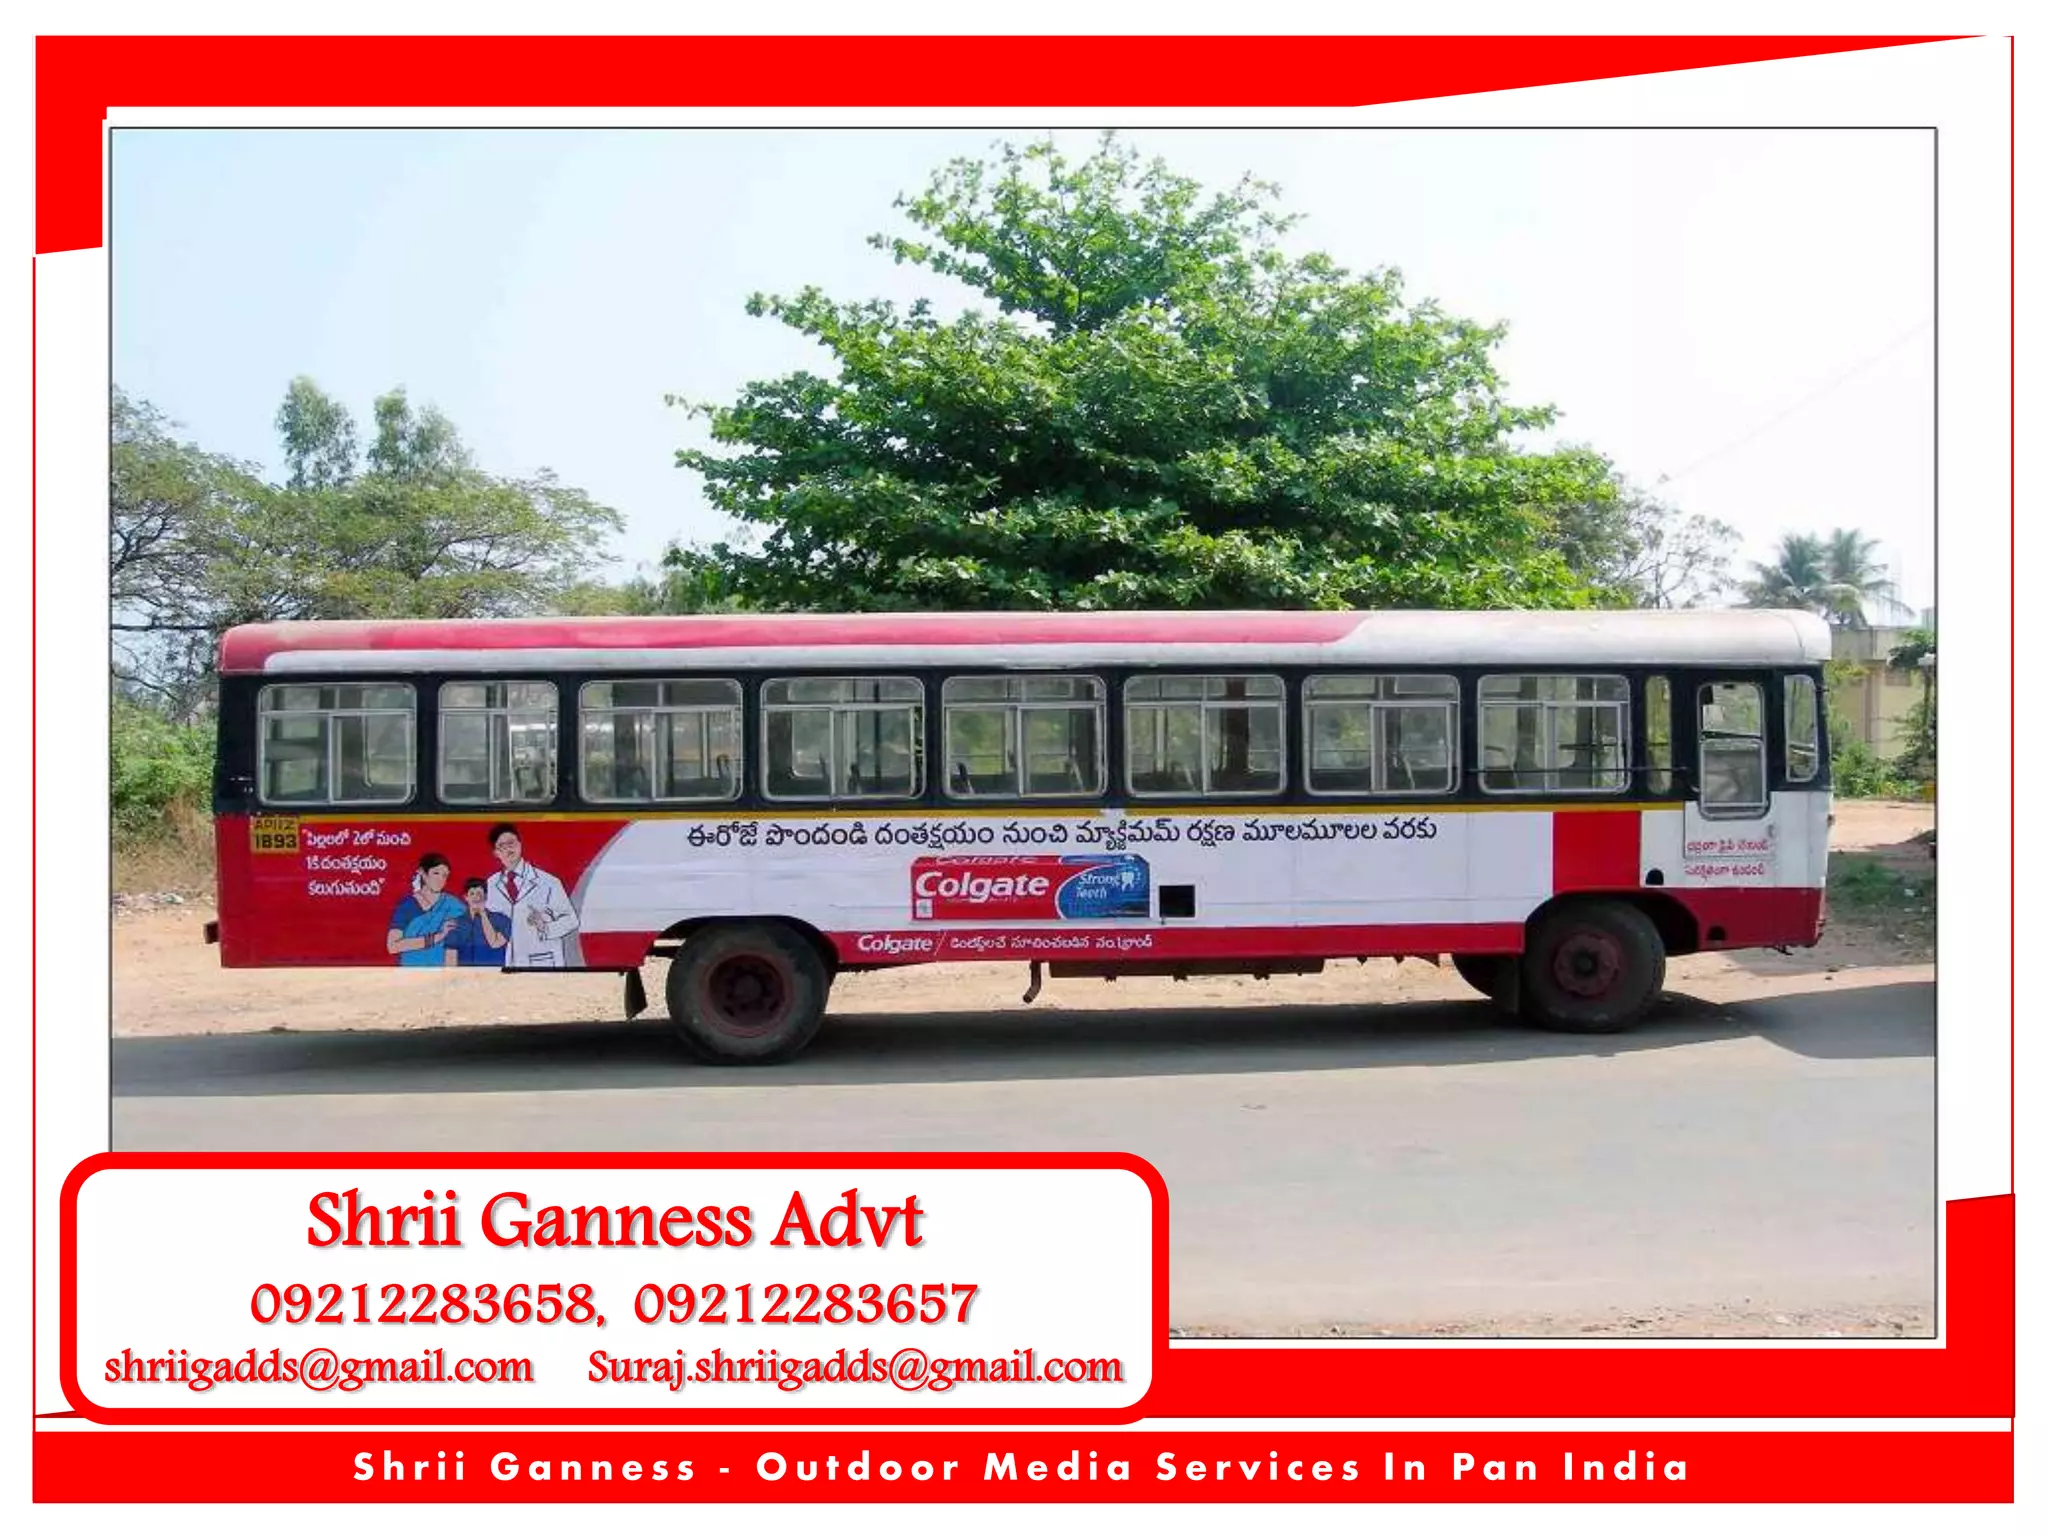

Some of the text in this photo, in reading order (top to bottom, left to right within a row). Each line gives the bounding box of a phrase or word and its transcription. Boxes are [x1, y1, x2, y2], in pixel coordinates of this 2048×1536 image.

[256, 833, 297, 849] 1893
[687, 820, 759, 847] ఈరోజే
[765, 821, 868, 846] పొందండి
[874, 821, 995, 851] దంతక్షయం
[1002, 821, 1069, 844] నుంచి
[1186, 819, 1236, 847] రక్షణ
[1242, 817, 1378, 841] మూలమూలల
[1382, 817, 1437, 840] వరకు
[915, 871, 1050, 904] Colgate
[857, 934, 933, 954] Colgate
